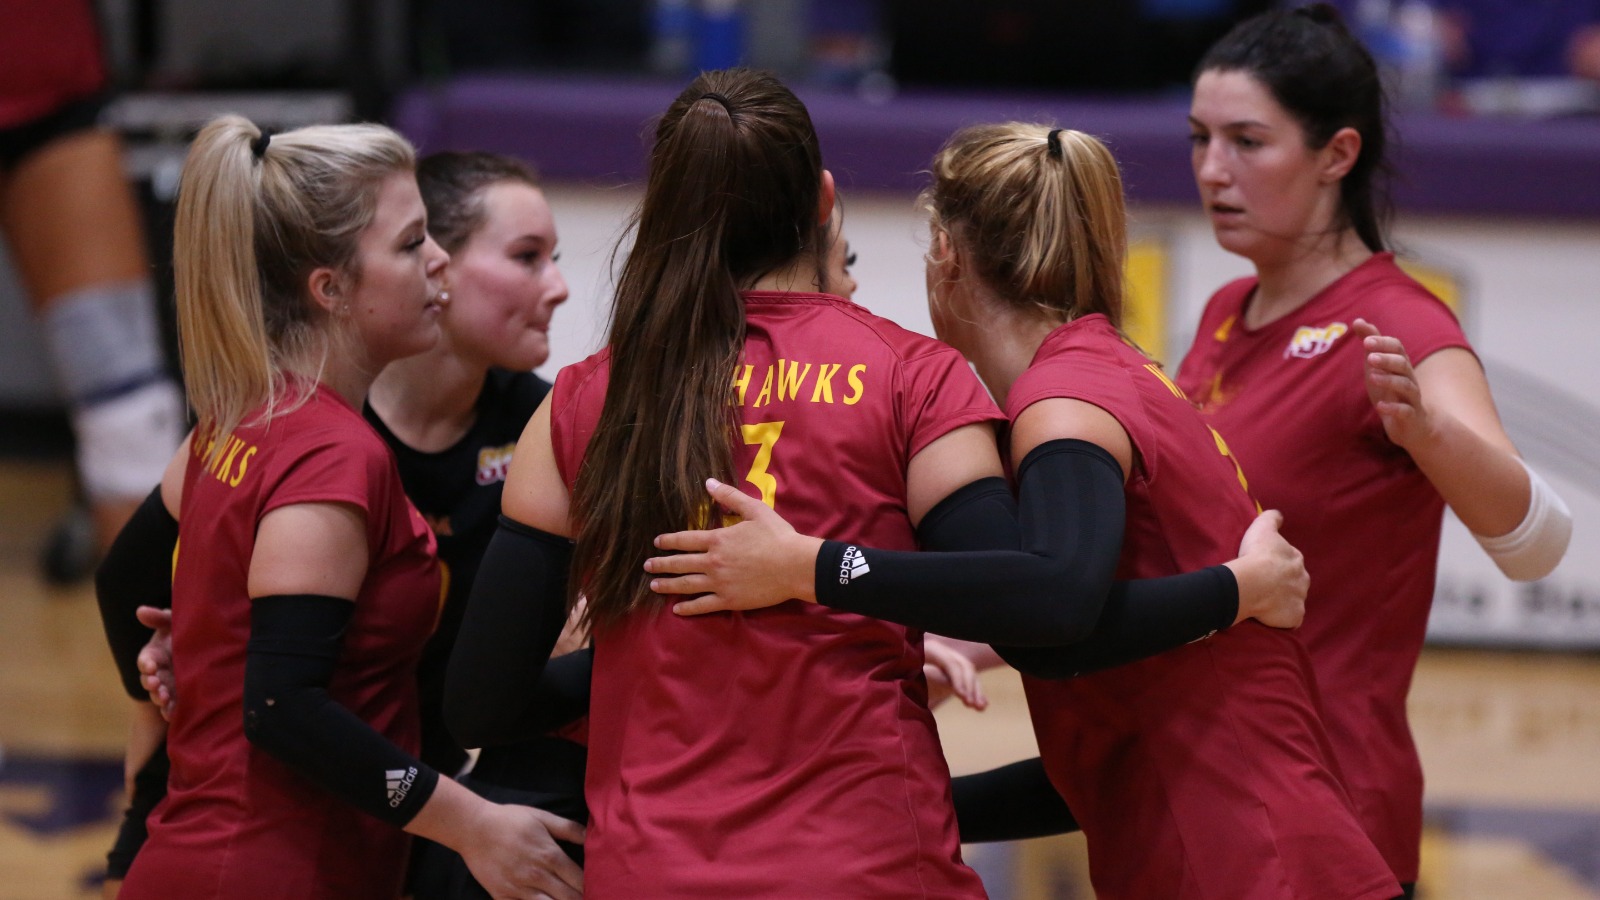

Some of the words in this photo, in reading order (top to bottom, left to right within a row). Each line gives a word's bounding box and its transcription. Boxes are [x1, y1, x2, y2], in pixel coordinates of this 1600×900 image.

[728, 358, 867, 408] HAWKS
[839, 546, 857, 585] adidas
[390, 766, 418, 807] adidas
